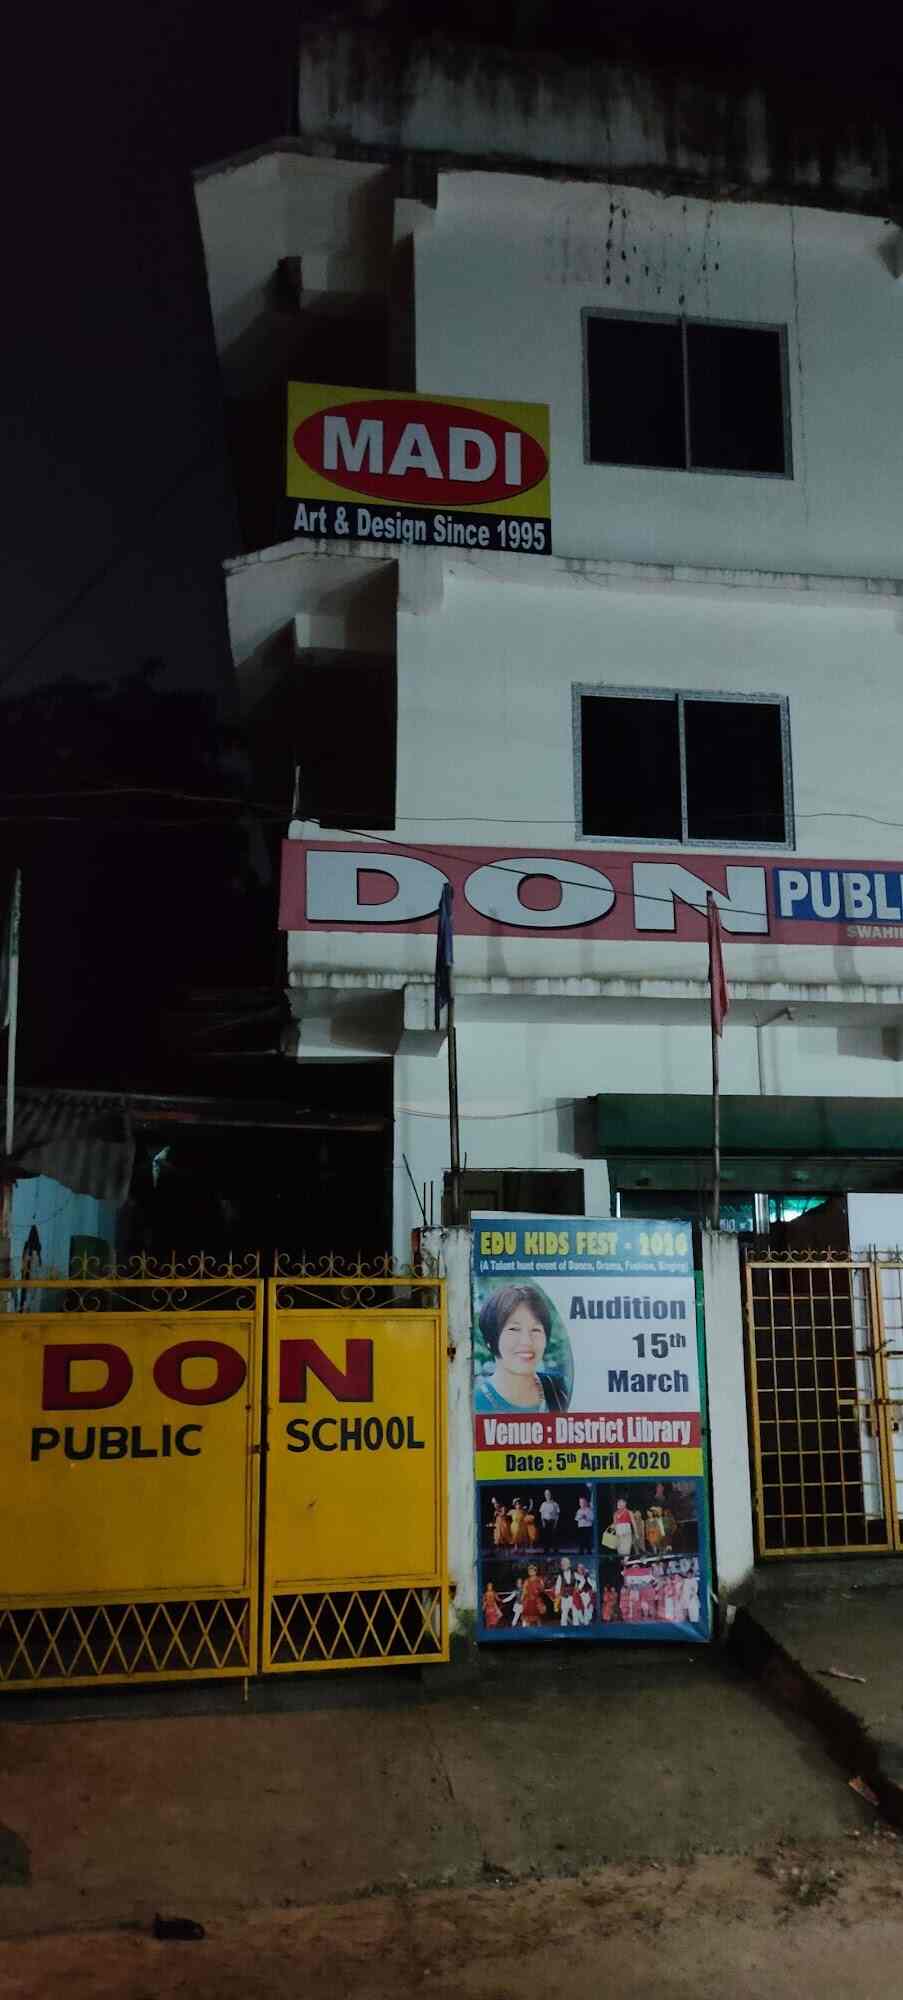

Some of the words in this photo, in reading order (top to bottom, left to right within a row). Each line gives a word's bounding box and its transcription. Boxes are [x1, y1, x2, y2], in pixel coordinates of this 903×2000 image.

[322, 415, 523, 487] MADI
[293, 503, 327, 533] Art
[334, 506, 350, 535] &
[357, 508, 427, 544] Design
[433, 514, 490, 548] Since
[497, 519, 546, 551] 1995
[305, 849, 770, 935] DON
[778, 870, 903, 920] PUBL
[848, 924, 903, 939] SWAHI
[480, 1231, 517, 1255] EDU
[524, 1231, 569, 1256] KIDS
[576, 1231, 618, 1256] FEST
[569, 1296, 686, 1320] Audition
[632, 1332, 687, 1359] 15th
[42, 1338, 374, 1411] DON
[608, 1369, 689, 1393] March
[30, 1423, 203, 1462] PUBLIC
[286, 1416, 425, 1454] SCHOOL
[483, 1418, 544, 1446] Venue
[556, 1416, 625, 1445] District
[626, 1416, 691, 1446] Library
[505, 1453, 544, 1473] Date
[556, 1452, 577, 1470] 5th
[580, 1452, 623, 1472] April,
[628, 1451, 670, 1470] 2020
